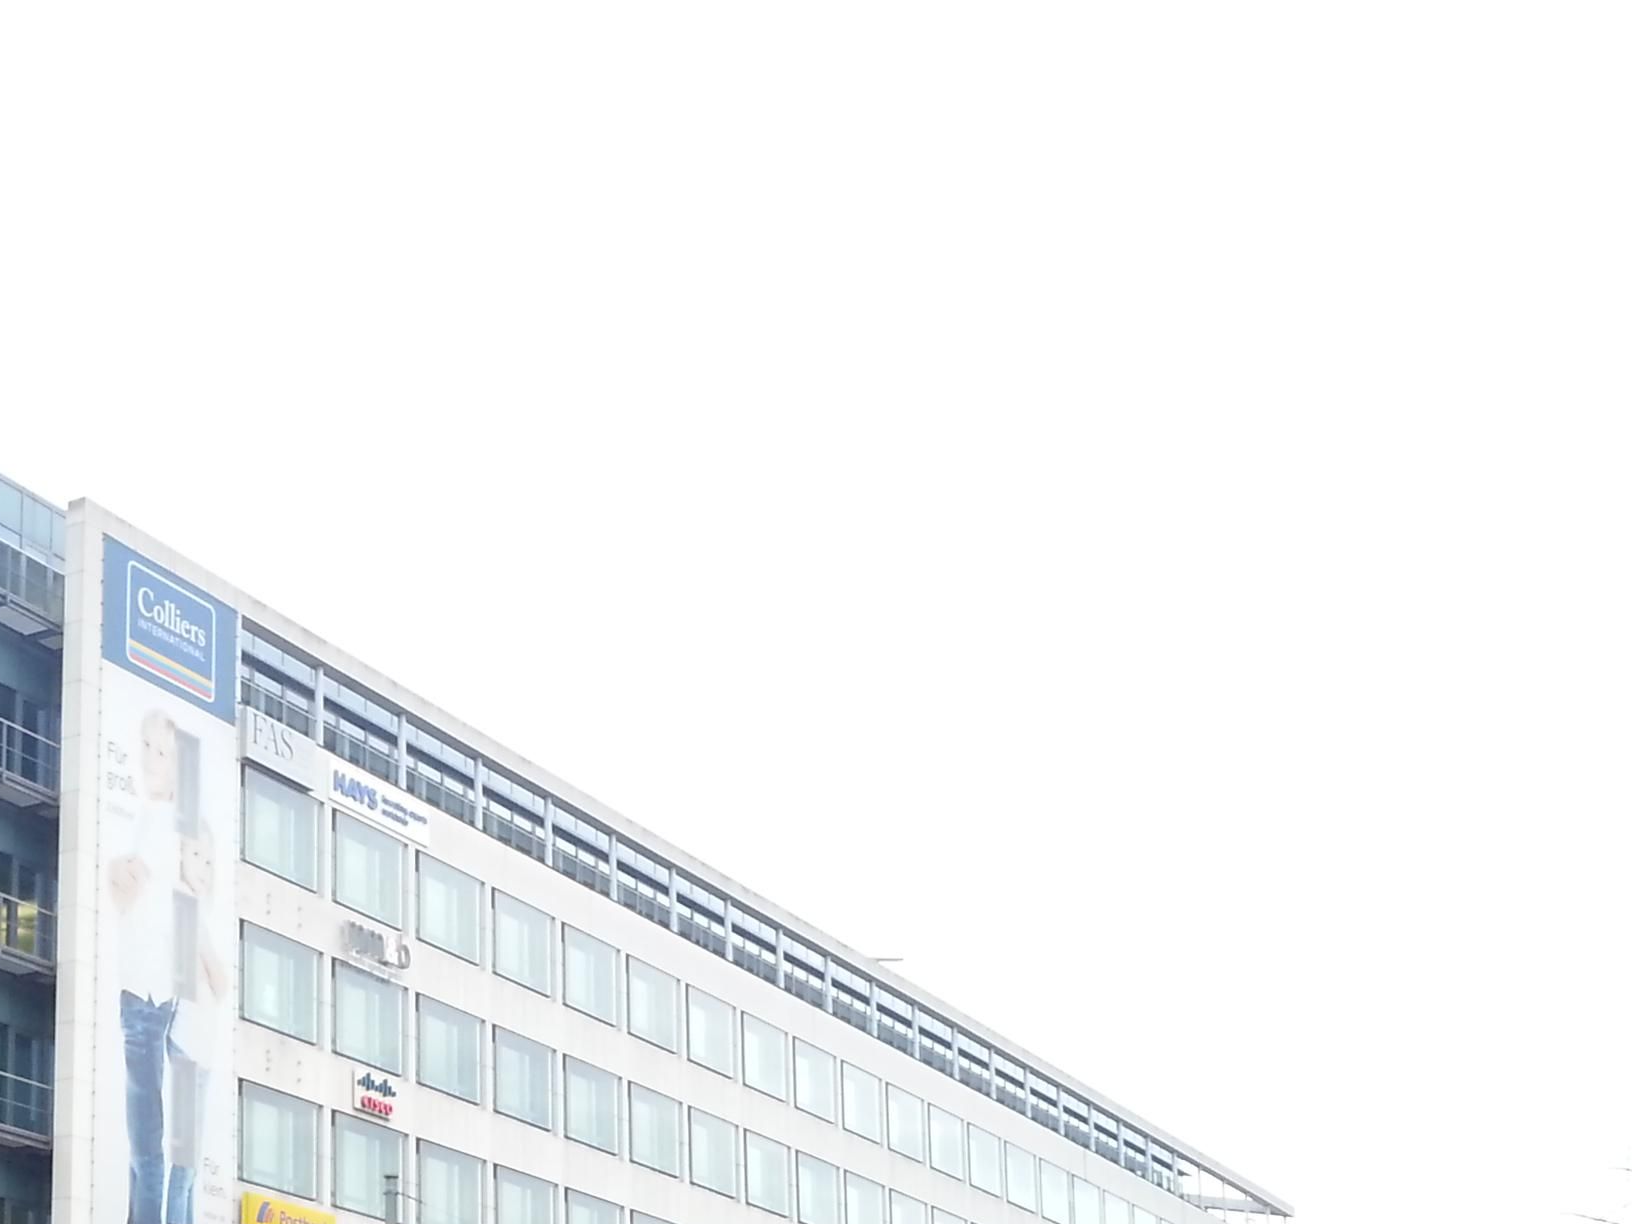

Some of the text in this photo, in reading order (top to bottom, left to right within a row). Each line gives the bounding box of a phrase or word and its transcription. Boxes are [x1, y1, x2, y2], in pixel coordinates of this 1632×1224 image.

[137, 587, 206, 647] Colliers
[137, 618, 206, 662] INTERNATIONAL
[253, 712, 294, 761] FAS
[333, 769, 378, 810] HAYS
